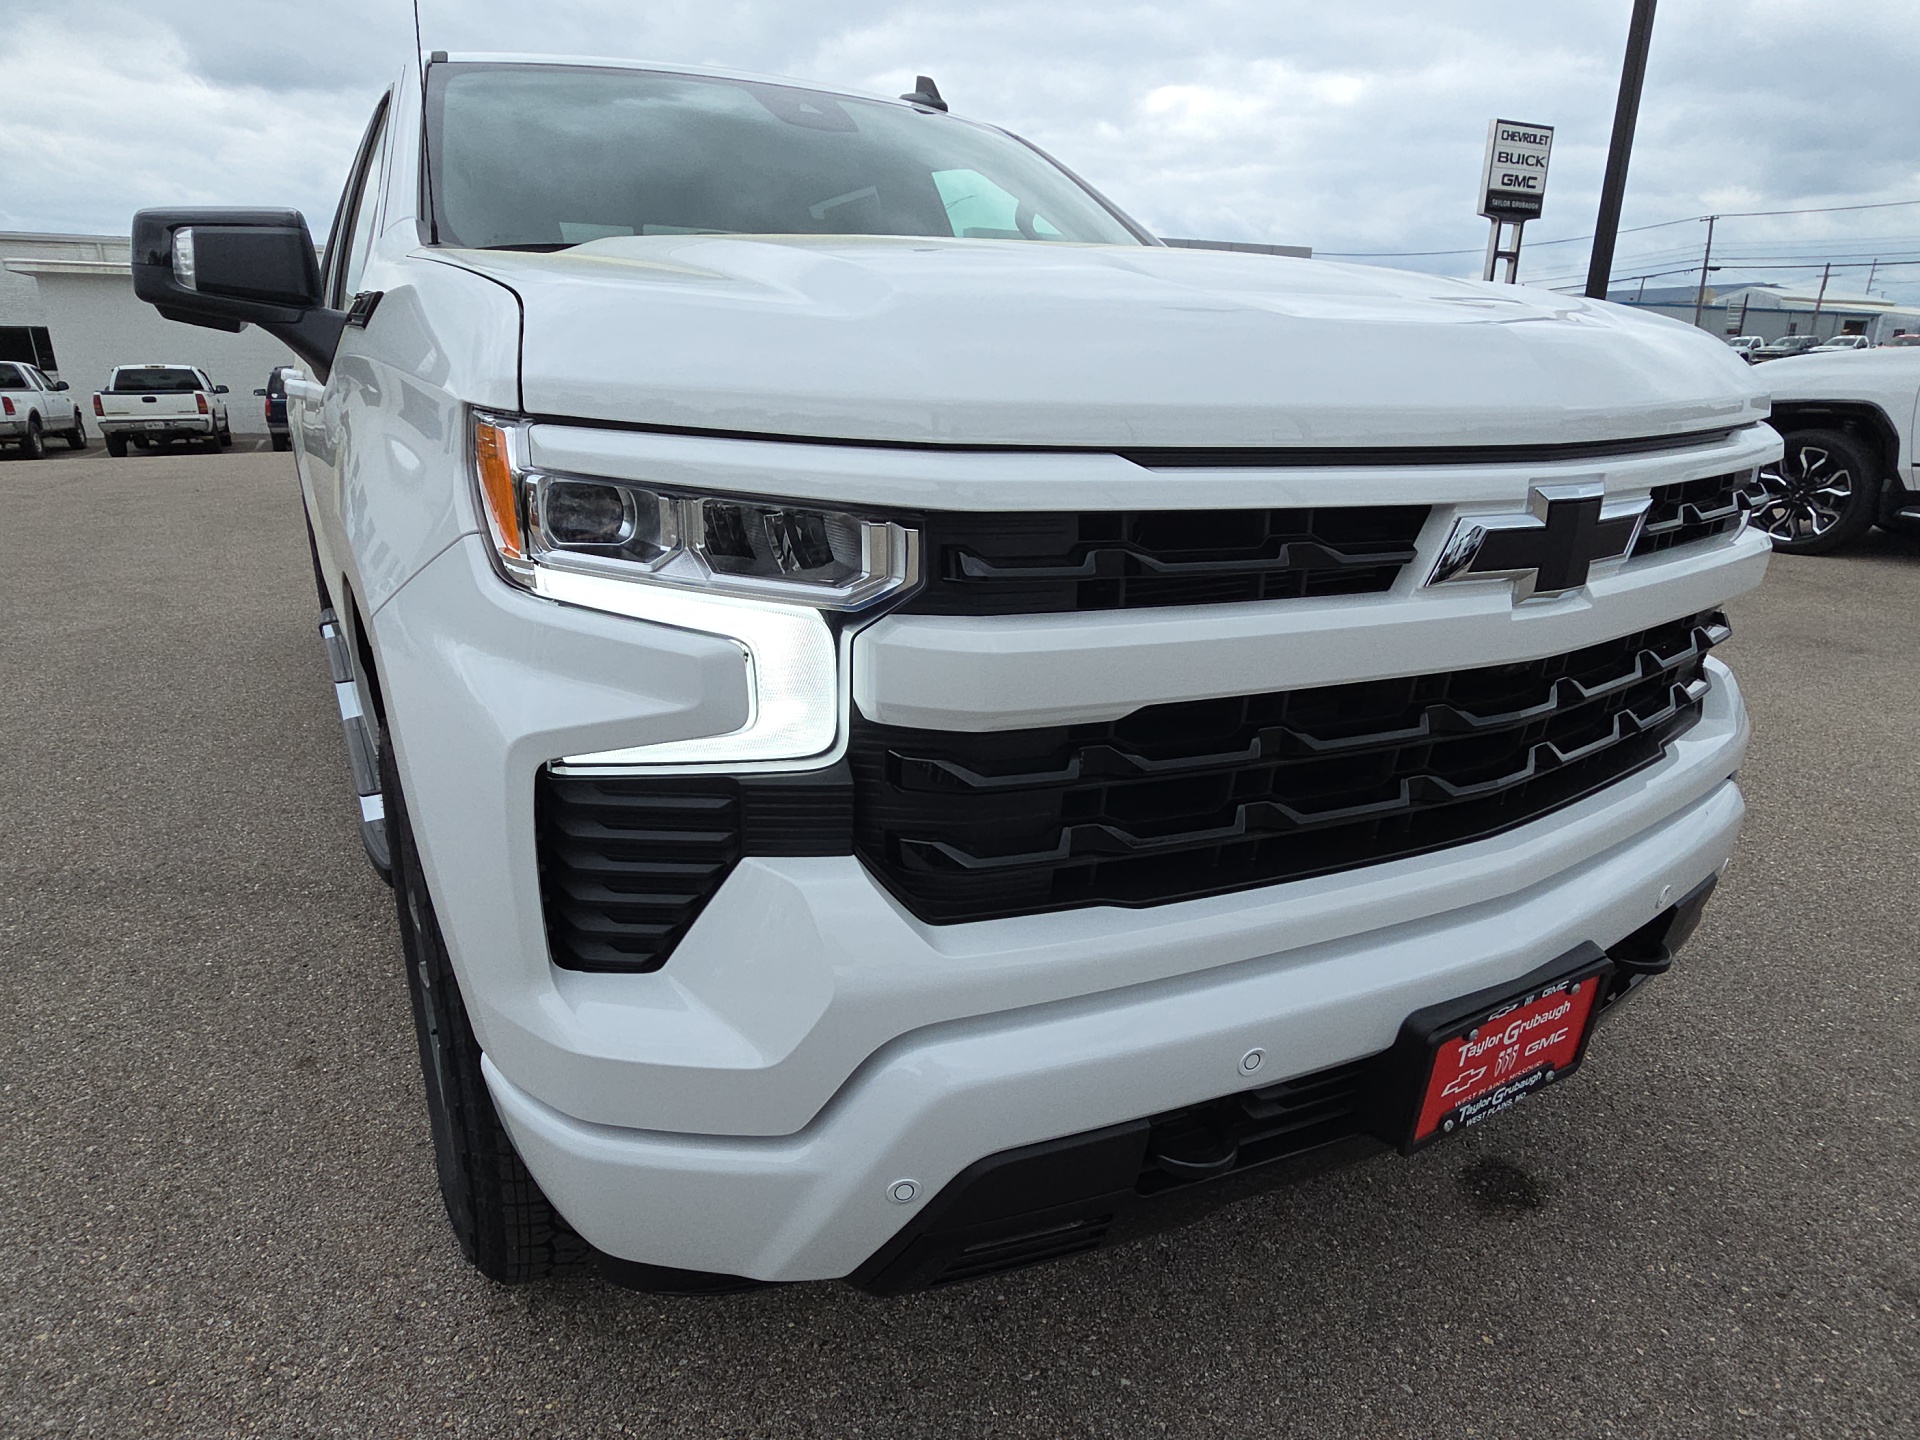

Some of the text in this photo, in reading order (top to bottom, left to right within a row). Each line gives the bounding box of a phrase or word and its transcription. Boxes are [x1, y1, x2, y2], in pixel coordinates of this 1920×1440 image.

[1501, 130, 1549, 145] CHEVROLET
[1497, 151, 1546, 168] BUICK
[1501, 173, 1538, 189] GMC
[1542, 980, 1570, 998] GMC
[1458, 1000, 1571, 1067] Taylor Grubaugh
[1524, 1027, 1569, 1057] GMC
[1459, 1071, 1542, 1123] Taylor Grubaugh
[1466, 1110, 1487, 1127] WEST
[1515, 1091, 1527, 1103] MO
